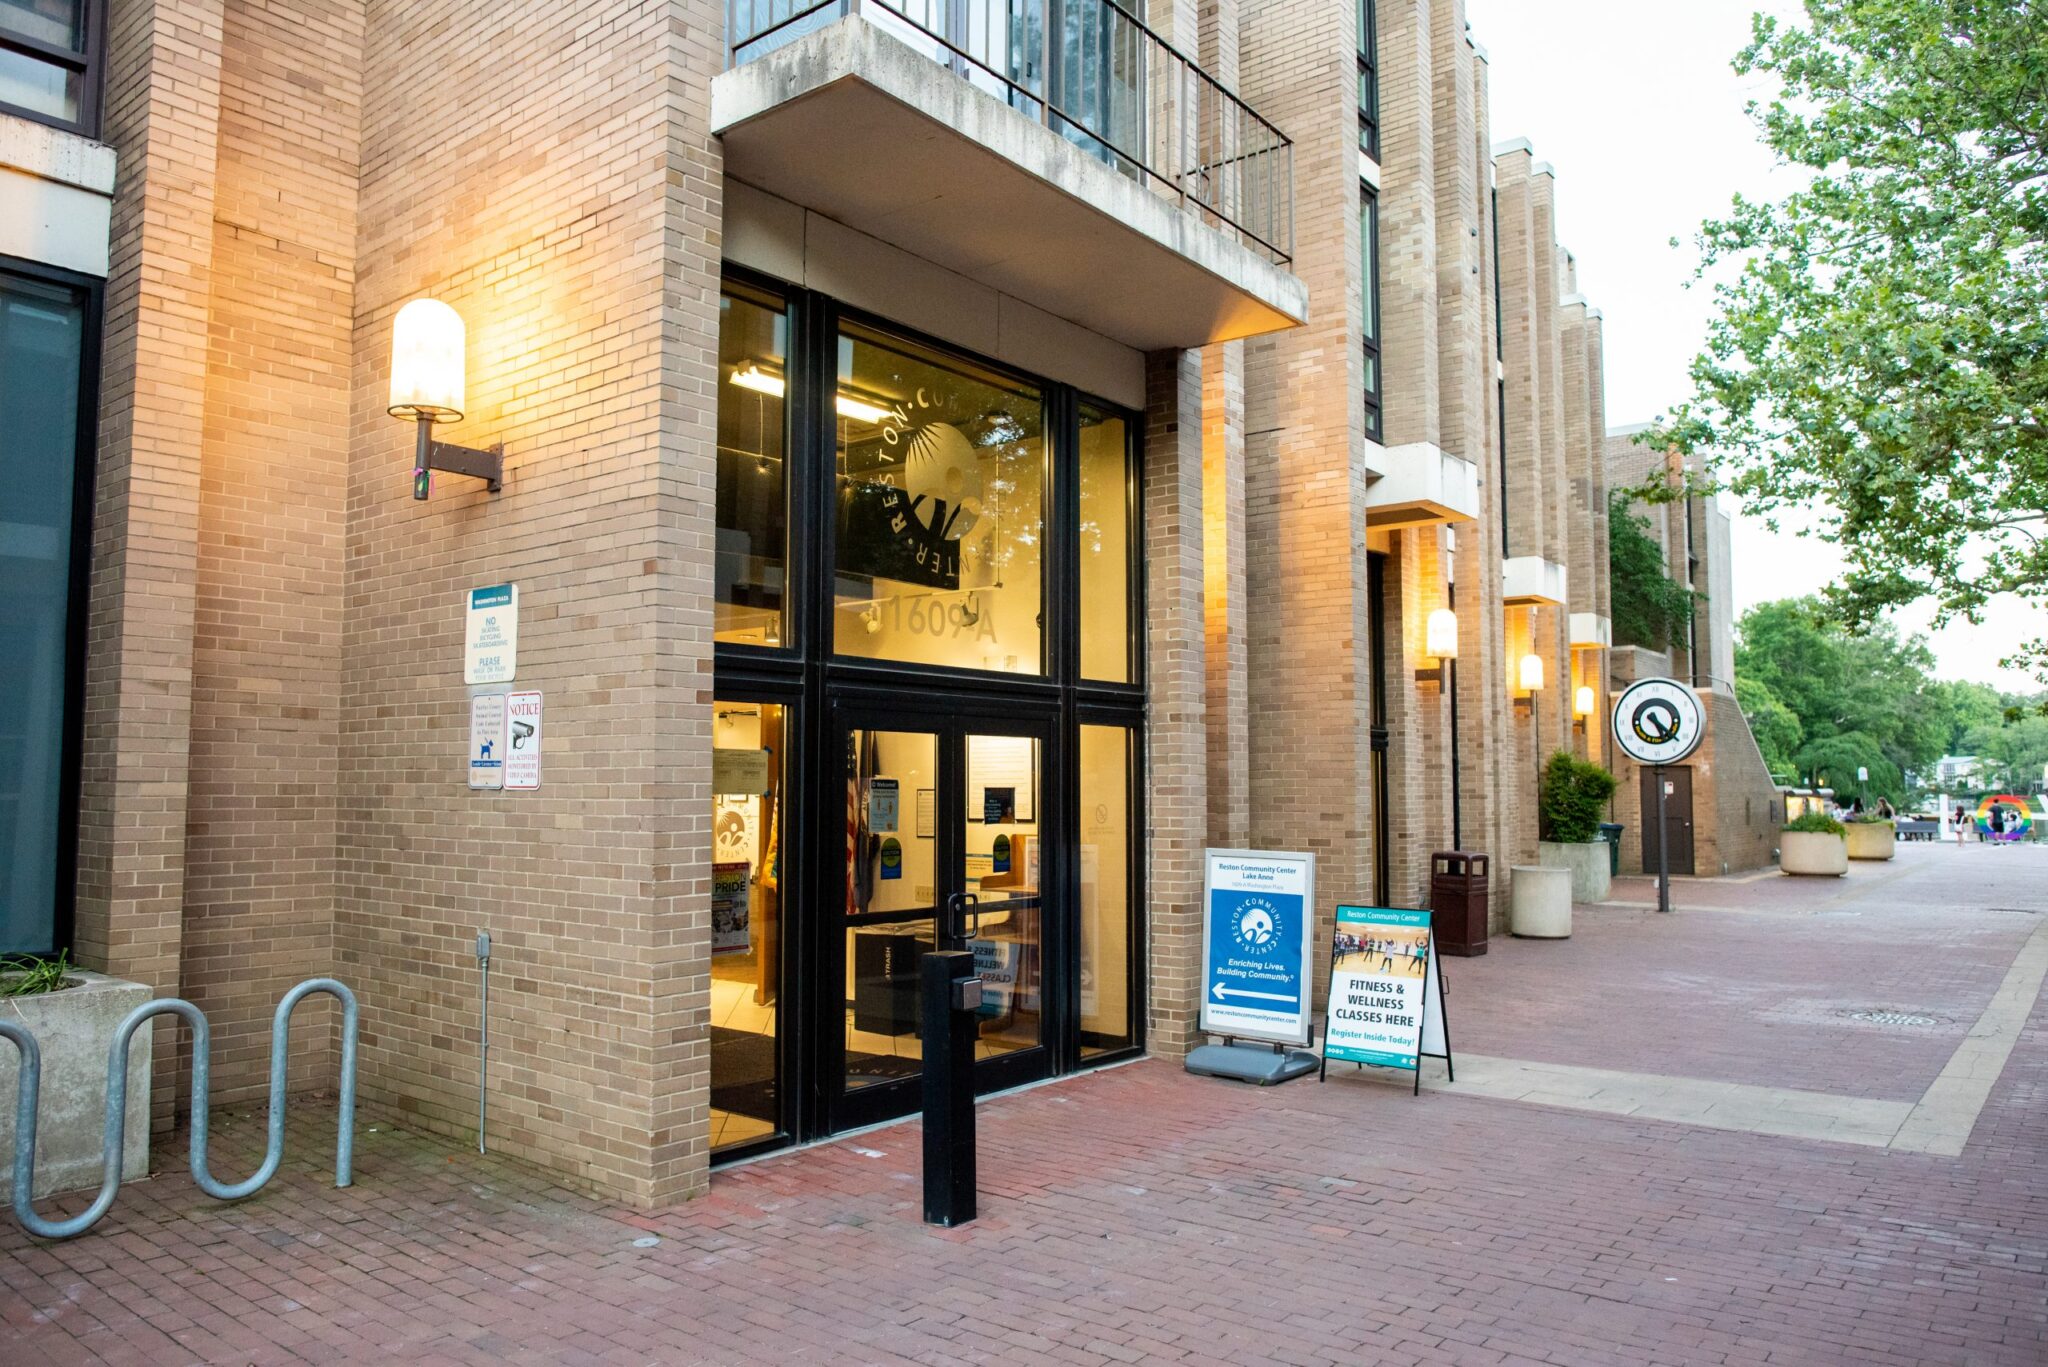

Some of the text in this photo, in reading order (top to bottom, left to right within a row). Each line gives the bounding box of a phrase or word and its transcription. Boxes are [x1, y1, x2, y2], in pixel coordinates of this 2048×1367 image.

[486, 616, 496, 625] NO
[480, 656, 500, 666] PLEASE
[510, 703, 540, 716] NOTICE
[1219, 863, 1296, 874] Reston Community Center
[715, 881, 746, 893] PRIDE
[1245, 898, 1282, 937] COMMUNITY
[1347, 910, 1420, 922] Reston Community Center
[1232, 906, 1243, 943] RESTON
[1244, 940, 1277, 955] CENTER
[1228, 958, 1285, 971] Enriching Lives.
[1217, 967, 1247, 979] Building
[1349, 979, 1405, 994] FITNESS &
[1348, 994, 1404, 1010] WELLNESS
[1211, 1009, 1297, 1024] www.restoncommunitycenter.com
[1336, 1008, 1414, 1027] CLASSES HERE
[1331, 1028, 1415, 1047] Register Inside Today!
